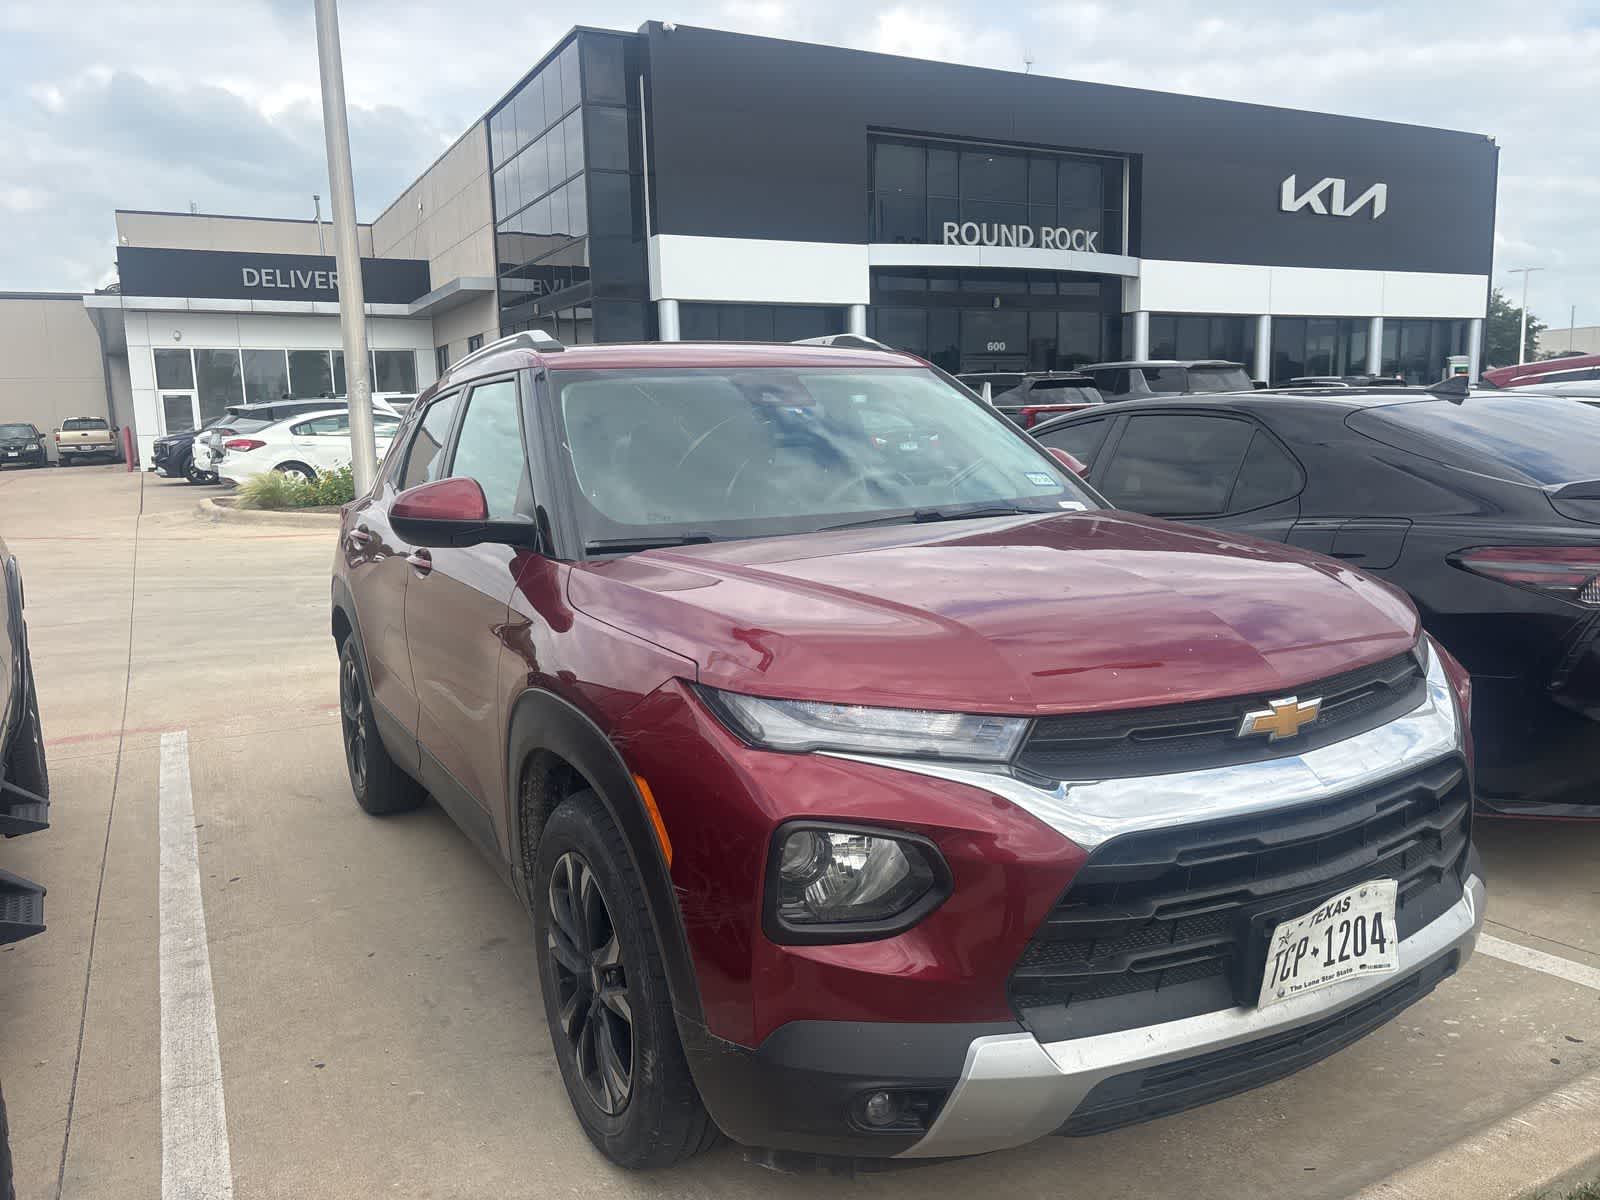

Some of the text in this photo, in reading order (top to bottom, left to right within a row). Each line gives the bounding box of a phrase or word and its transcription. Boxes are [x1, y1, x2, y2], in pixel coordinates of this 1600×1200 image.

[1282, 173, 1387, 219] KIA
[943, 221, 1098, 253] ROUND ROCK
[241, 267, 339, 290] DELIVER
[986, 341, 1006, 351] 600
[1309, 896, 1351, 928] TEXAS
[1290, 967, 1353, 992] The Lone Star State
